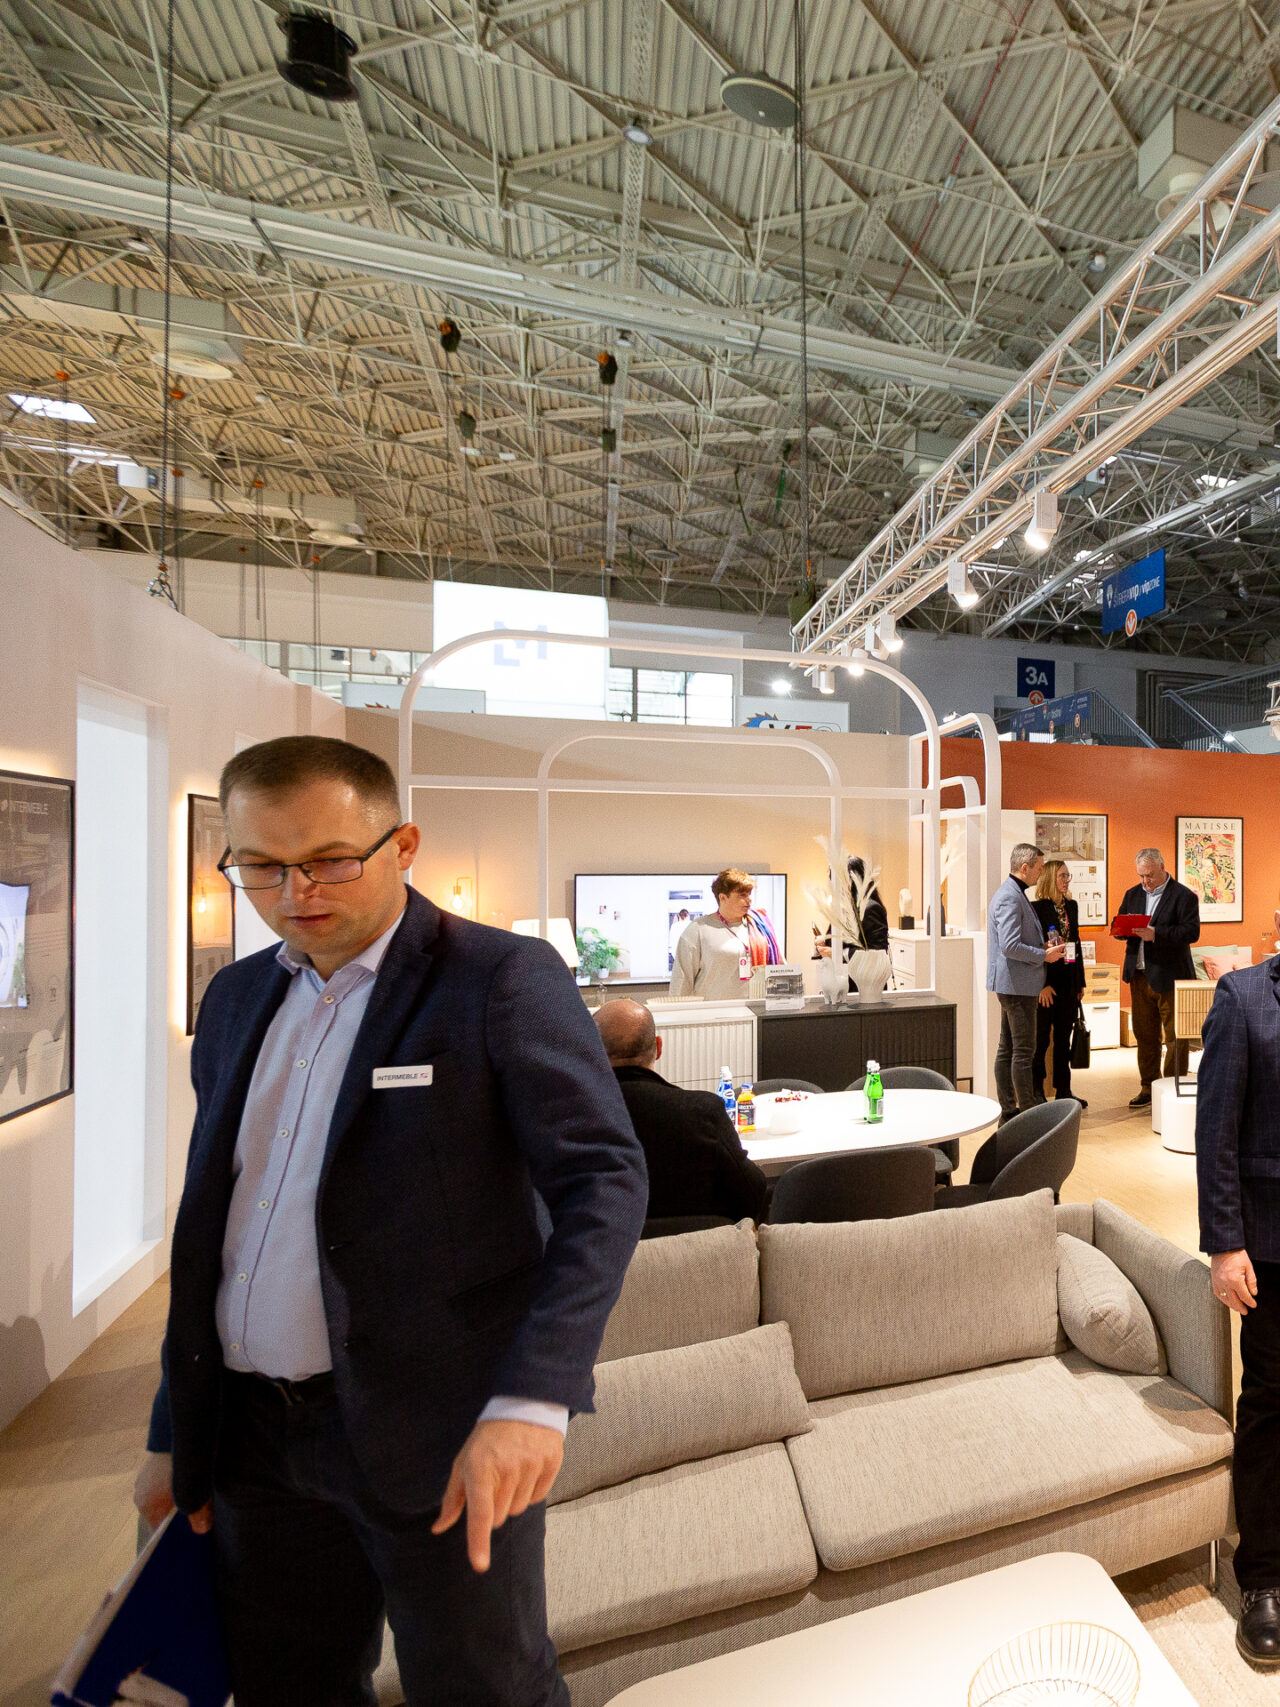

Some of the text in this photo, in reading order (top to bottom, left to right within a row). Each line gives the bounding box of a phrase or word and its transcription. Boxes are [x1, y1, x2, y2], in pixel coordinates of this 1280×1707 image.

[1025, 666, 1049, 686] 3A
[1184, 822, 1237, 830] MATISSE
[376, 1073, 419, 1081] INTERMEBLE
